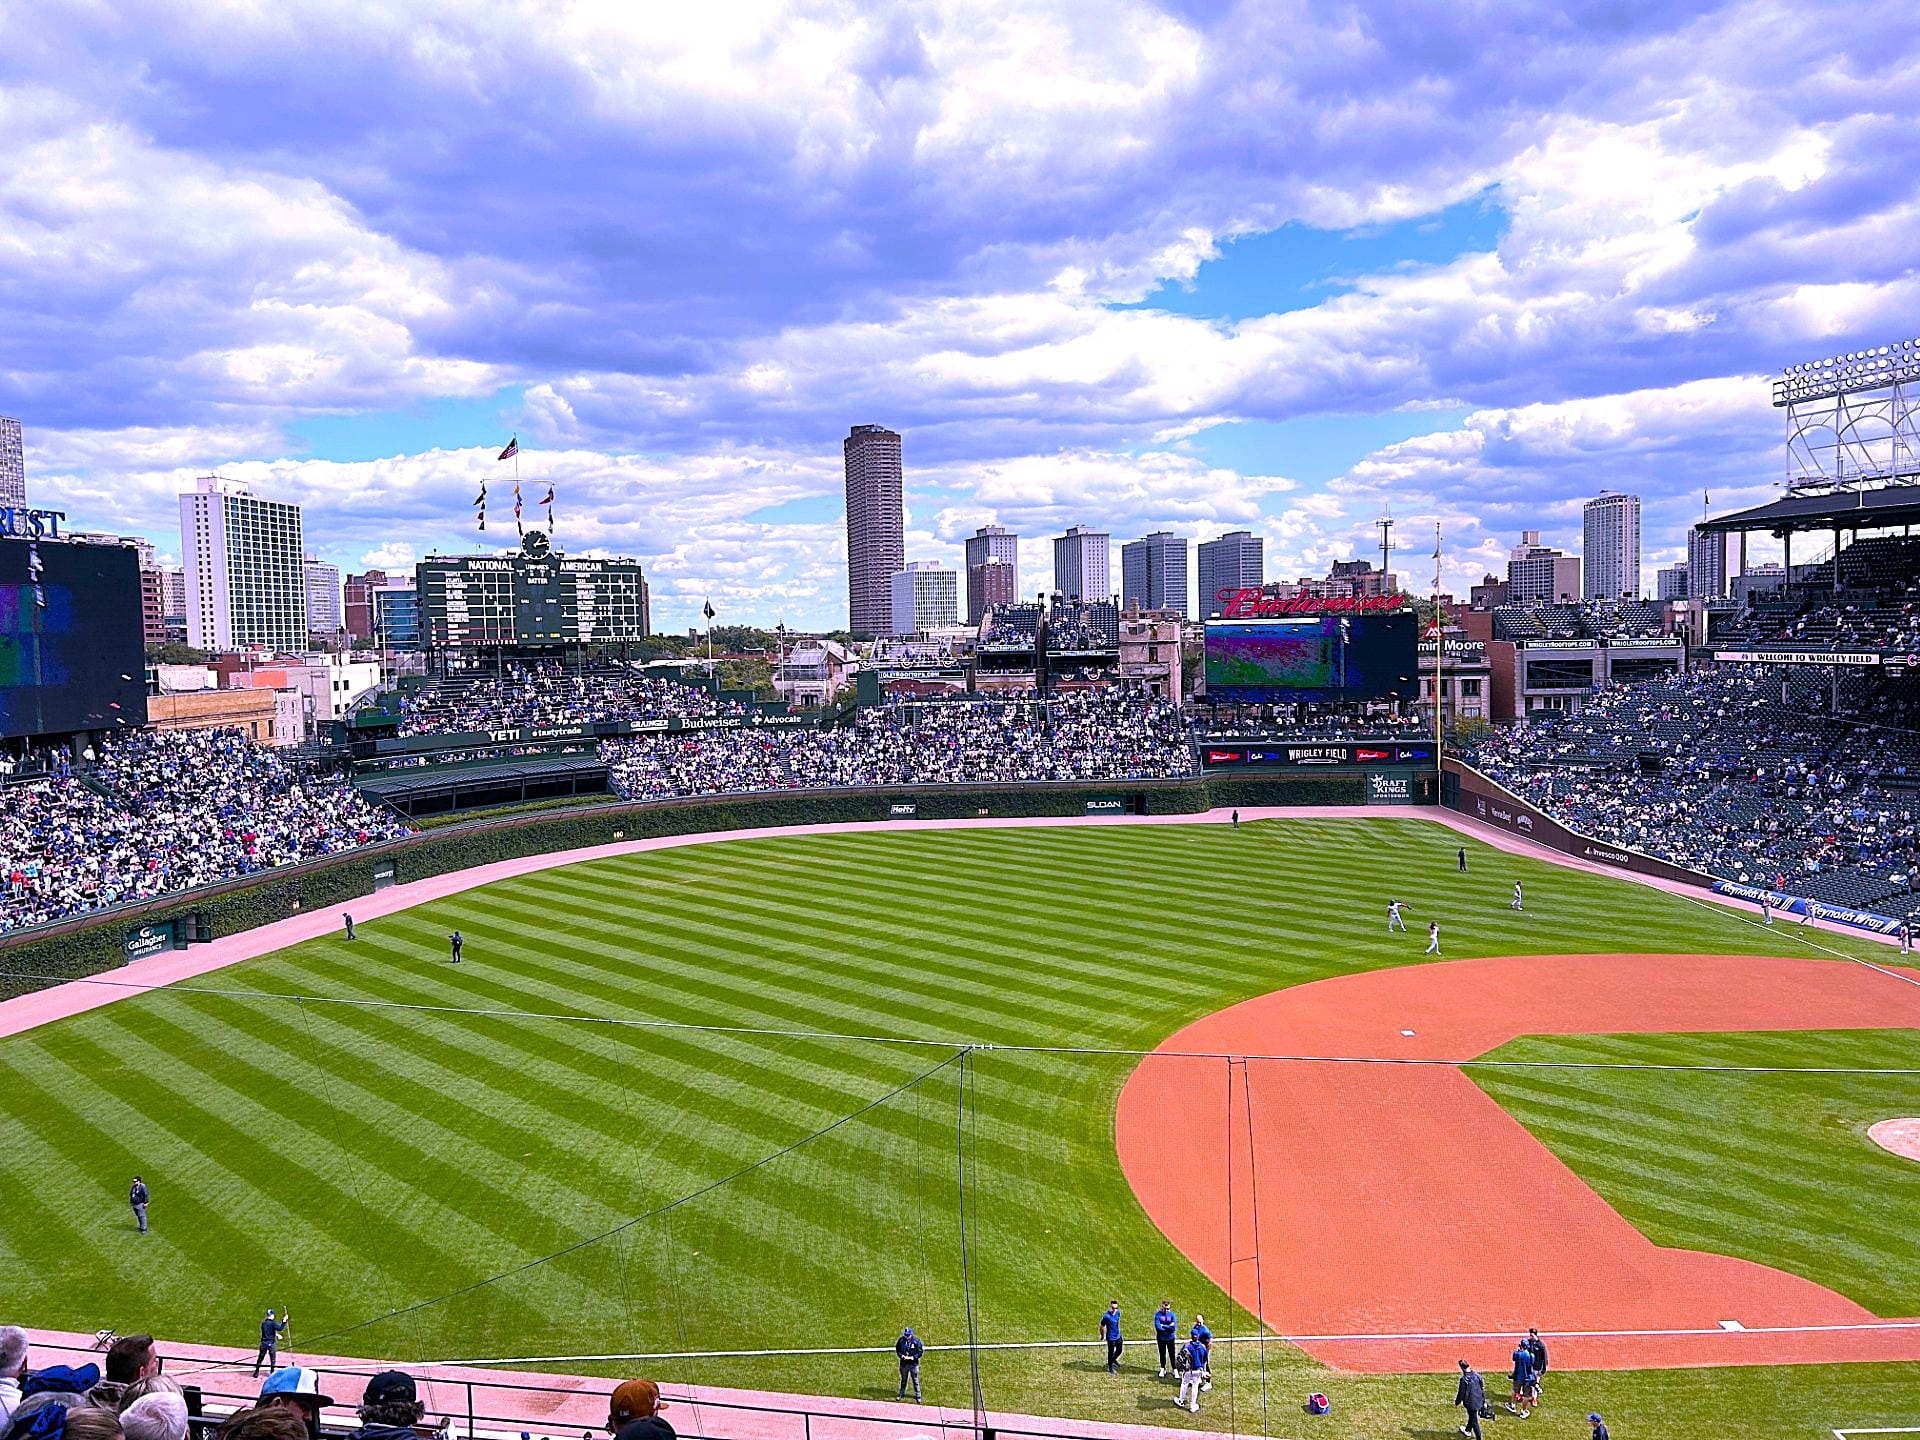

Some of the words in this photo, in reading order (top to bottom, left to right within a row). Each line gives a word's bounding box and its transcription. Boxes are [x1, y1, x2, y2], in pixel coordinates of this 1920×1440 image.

[468, 561, 514, 570] NATIONAL
[560, 562, 602, 571] AMERICAN
[1217, 587, 1405, 617] Budweiser
[1444, 640, 1484, 651] Moore
[1757, 653, 1794, 661] WELCOME
[1808, 654, 1850, 662] WRIGLEY
[1850, 655, 1872, 663] FIELD
[630, 719, 669, 728] GRAINGER
[763, 715, 801, 724] Advocate
[488, 729, 520, 741] YETI
[539, 727, 582, 738] tastytrade
[1288, 749, 1323, 760] WRIGLEY
[1326, 748, 1347, 760] FIELD
[1373, 780, 1408, 788] DRAFT
[892, 805, 914, 813] Hefty
[1086, 800, 1121, 809] SLOAN
[1720, 882, 1758, 899] Reynolds
[1811, 903, 1855, 920] Reynolds
[1853, 913, 1885, 929] Wrap
[128, 934, 167, 950] Gallagher
